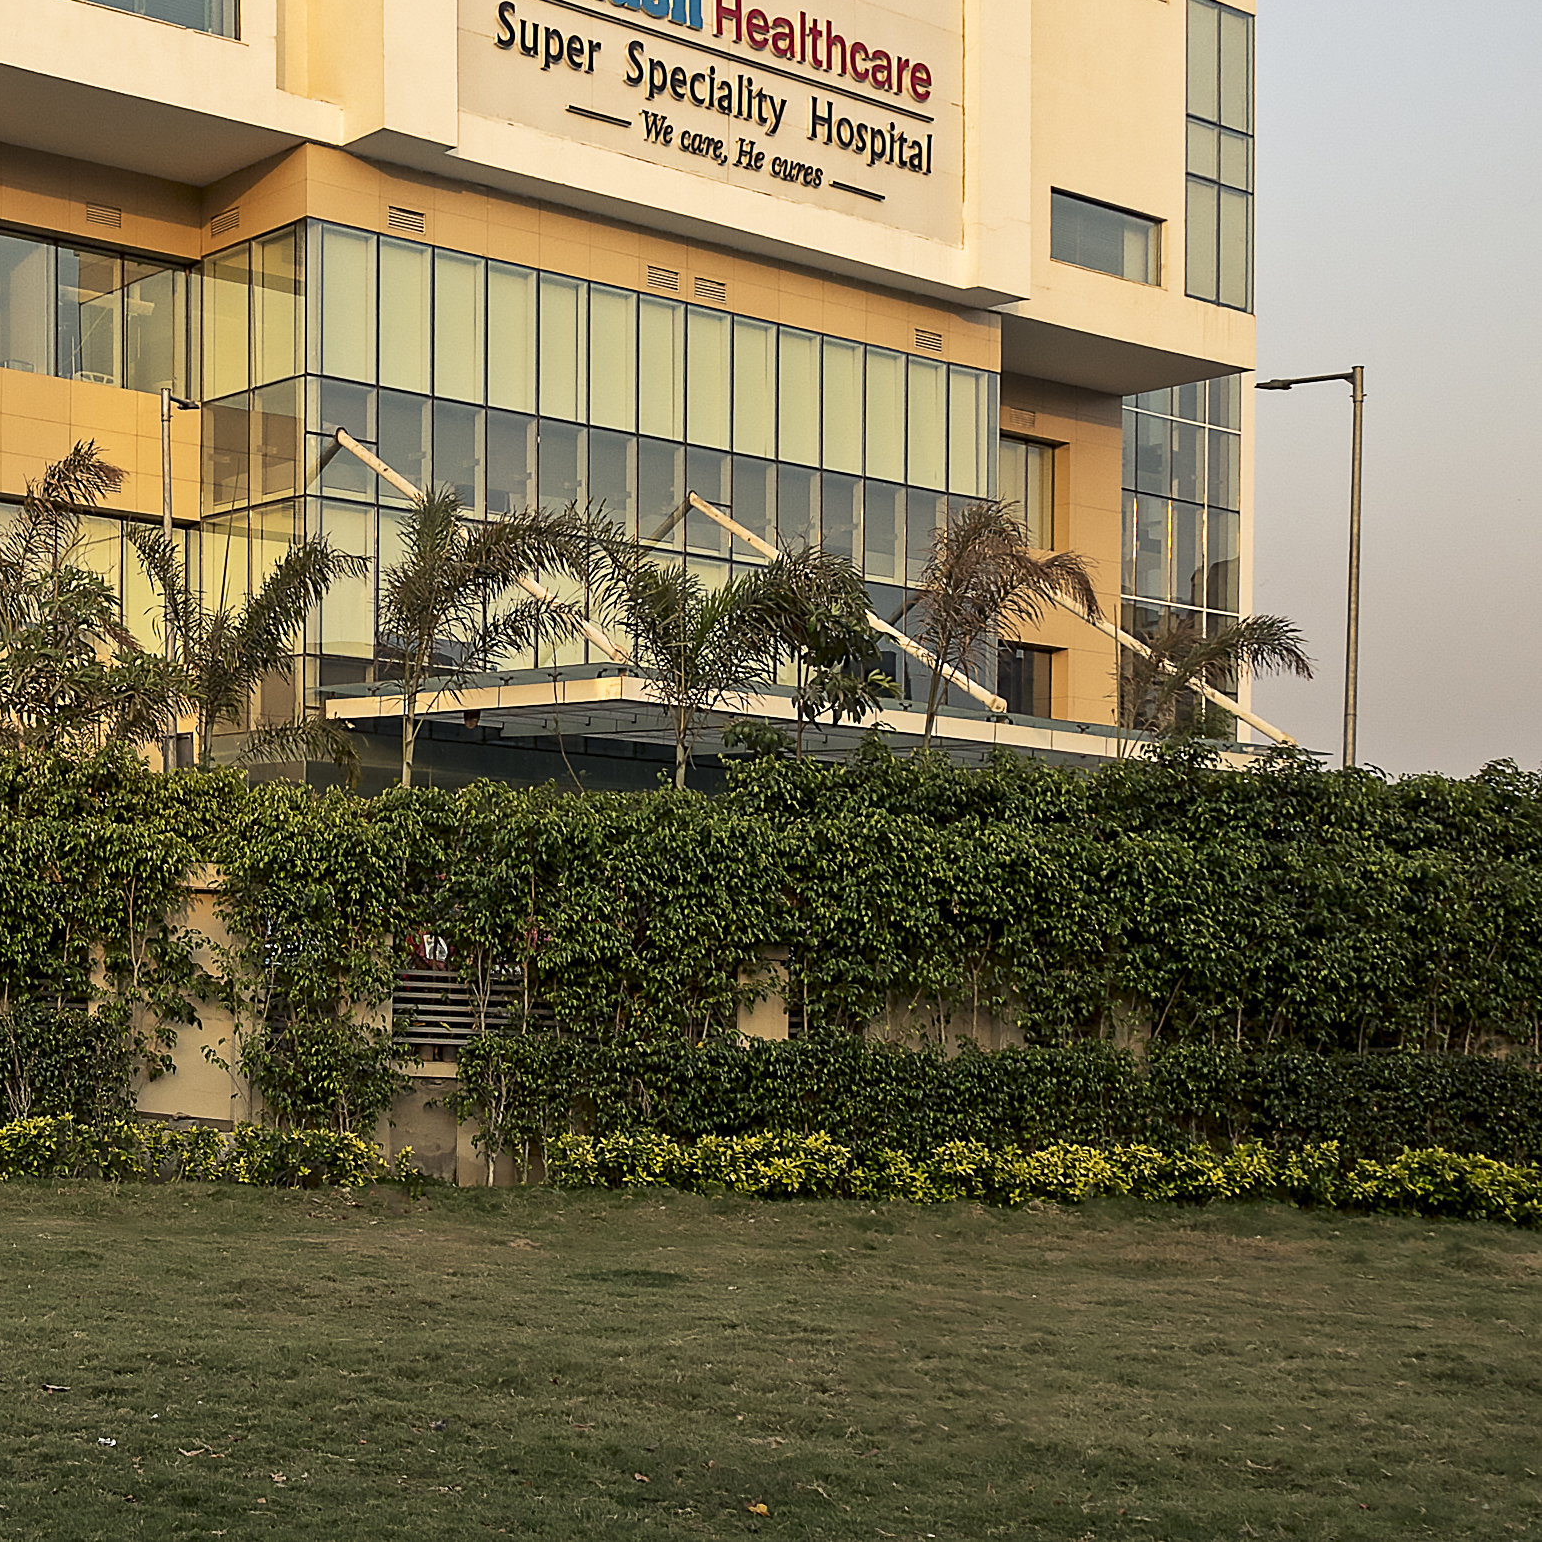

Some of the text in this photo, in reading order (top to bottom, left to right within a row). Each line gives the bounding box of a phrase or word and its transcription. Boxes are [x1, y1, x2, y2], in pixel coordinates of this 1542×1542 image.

[495, 1, 934, 174] Super Speciality Hospital
[639, 109, 824, 187] We care, He cures
